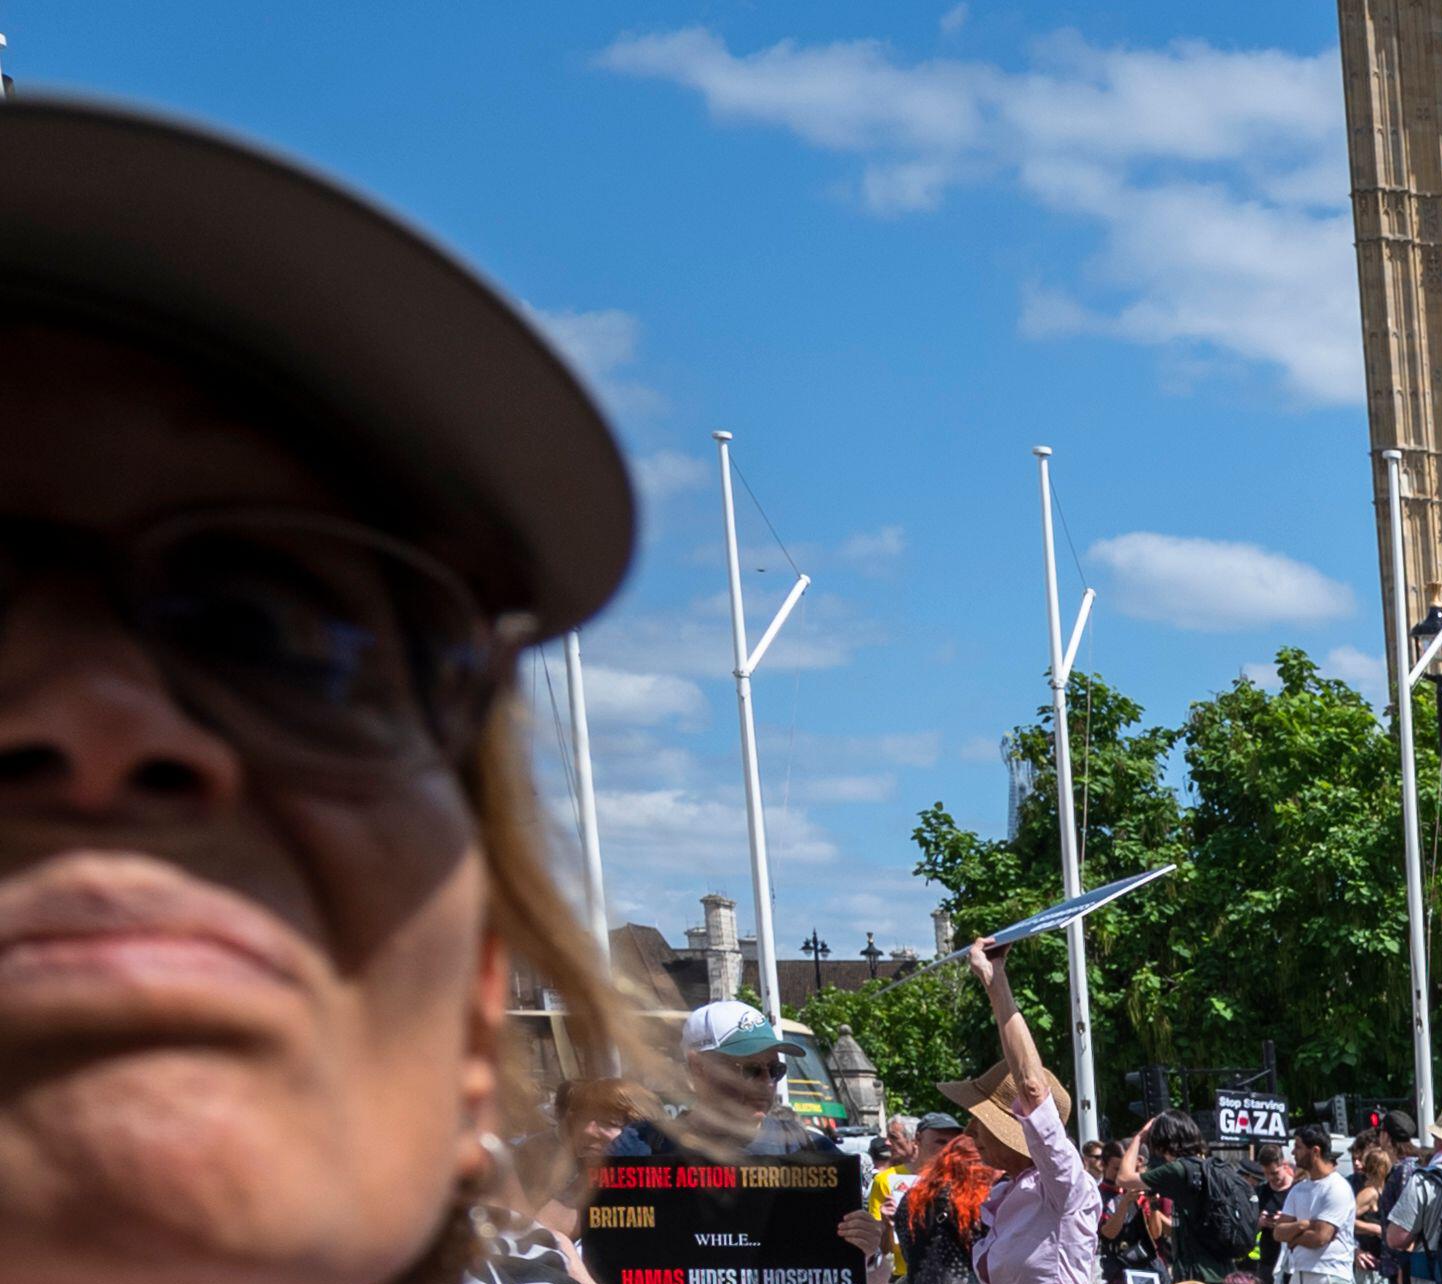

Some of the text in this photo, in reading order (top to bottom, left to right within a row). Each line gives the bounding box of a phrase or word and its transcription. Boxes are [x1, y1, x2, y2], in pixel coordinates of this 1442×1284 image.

[1219, 1096, 1285, 1112] Stop Starving
[1220, 1108, 1286, 1137] GAZA
[676, 1166, 736, 1189] ACTION
[740, 1166, 838, 1189] TERRORISES
[589, 1206, 656, 1229] BRITAIN
[694, 1233, 761, 1248] WHILE...
